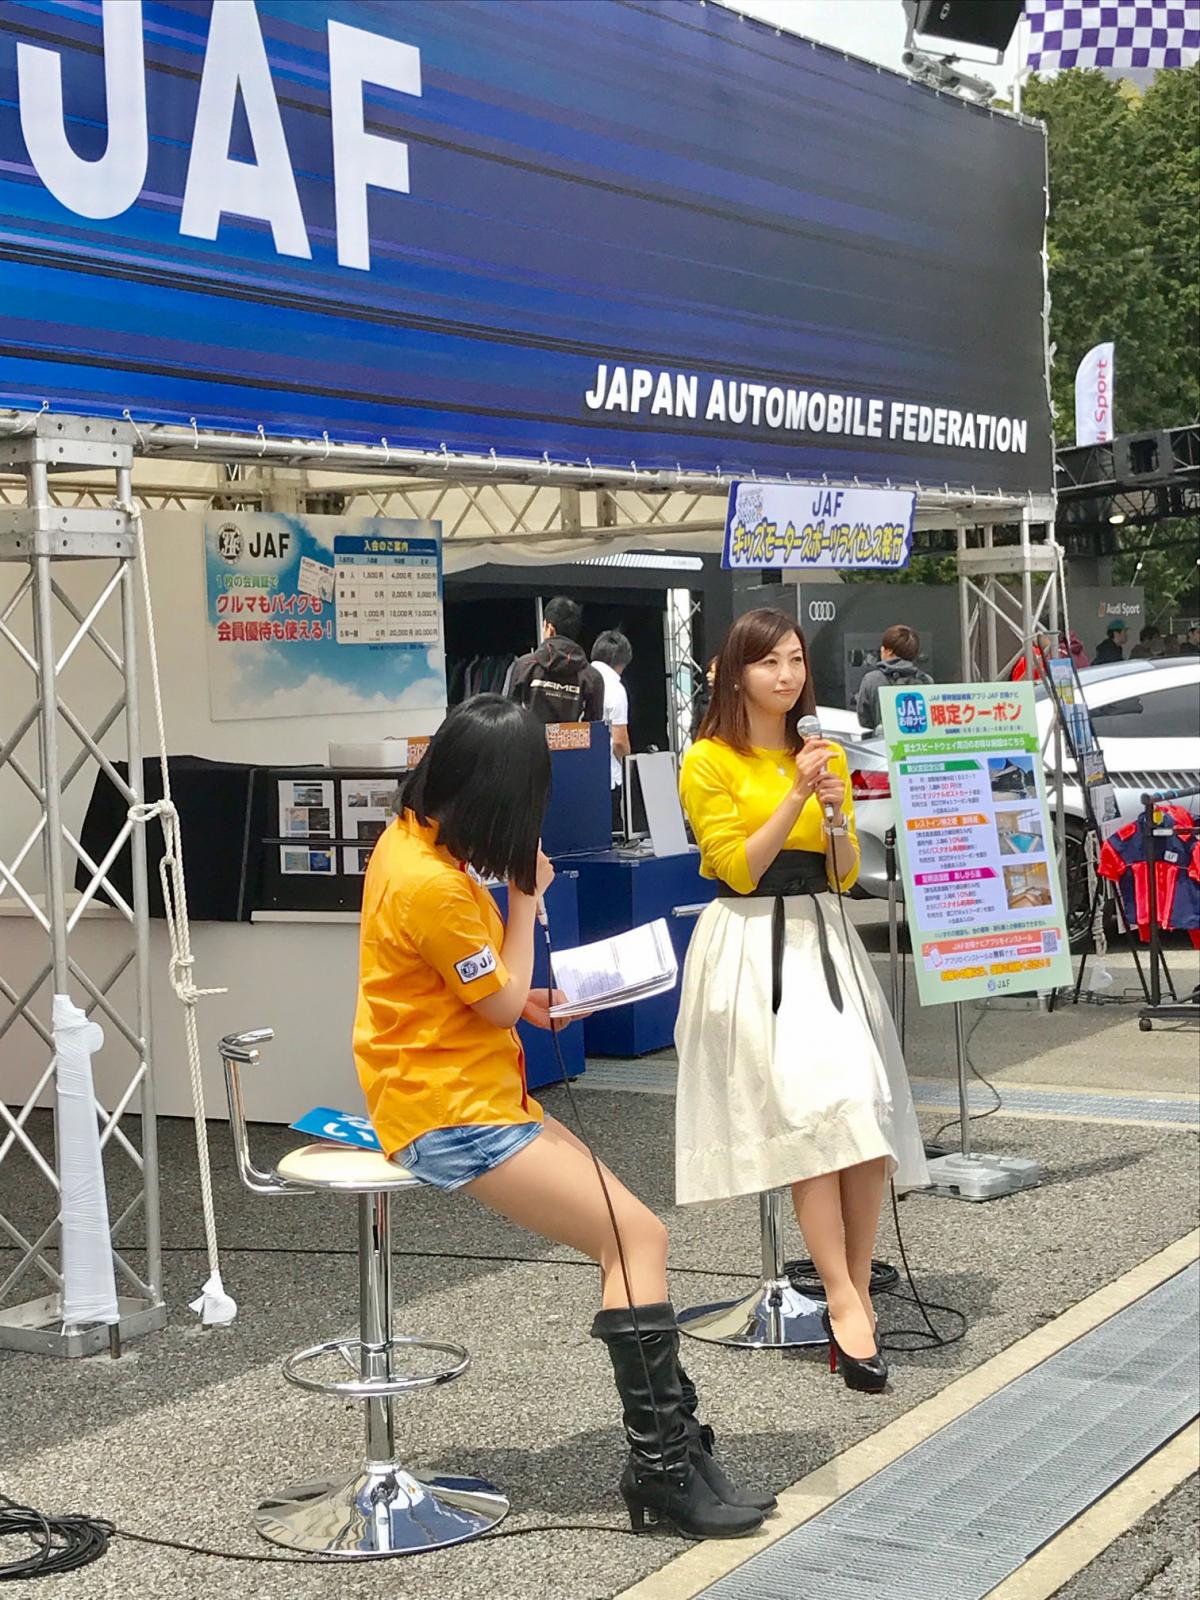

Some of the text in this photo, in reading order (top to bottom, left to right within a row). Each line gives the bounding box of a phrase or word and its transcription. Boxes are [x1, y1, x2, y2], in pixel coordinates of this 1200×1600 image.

[17, 0, 422, 271] JAF
[1095, 360, 1108, 422] Sport
[585, 364, 1028, 454] JAPAN AUTOMOBILE FEDERATION
[812, 490, 844, 518] JAF
[249, 532, 290, 558] JAF
[732, 518, 905, 565] キッズモータースポーツライセンス発行
[216, 593, 323, 614] クルマもバイクも
[1106, 602, 1140, 617] Audi Sport
[545, 680, 581, 694] AMG
[897, 700, 924, 717] JAF
[929, 702, 1023, 727] 限定クーポン
[997, 978, 1011, 989] JAF
